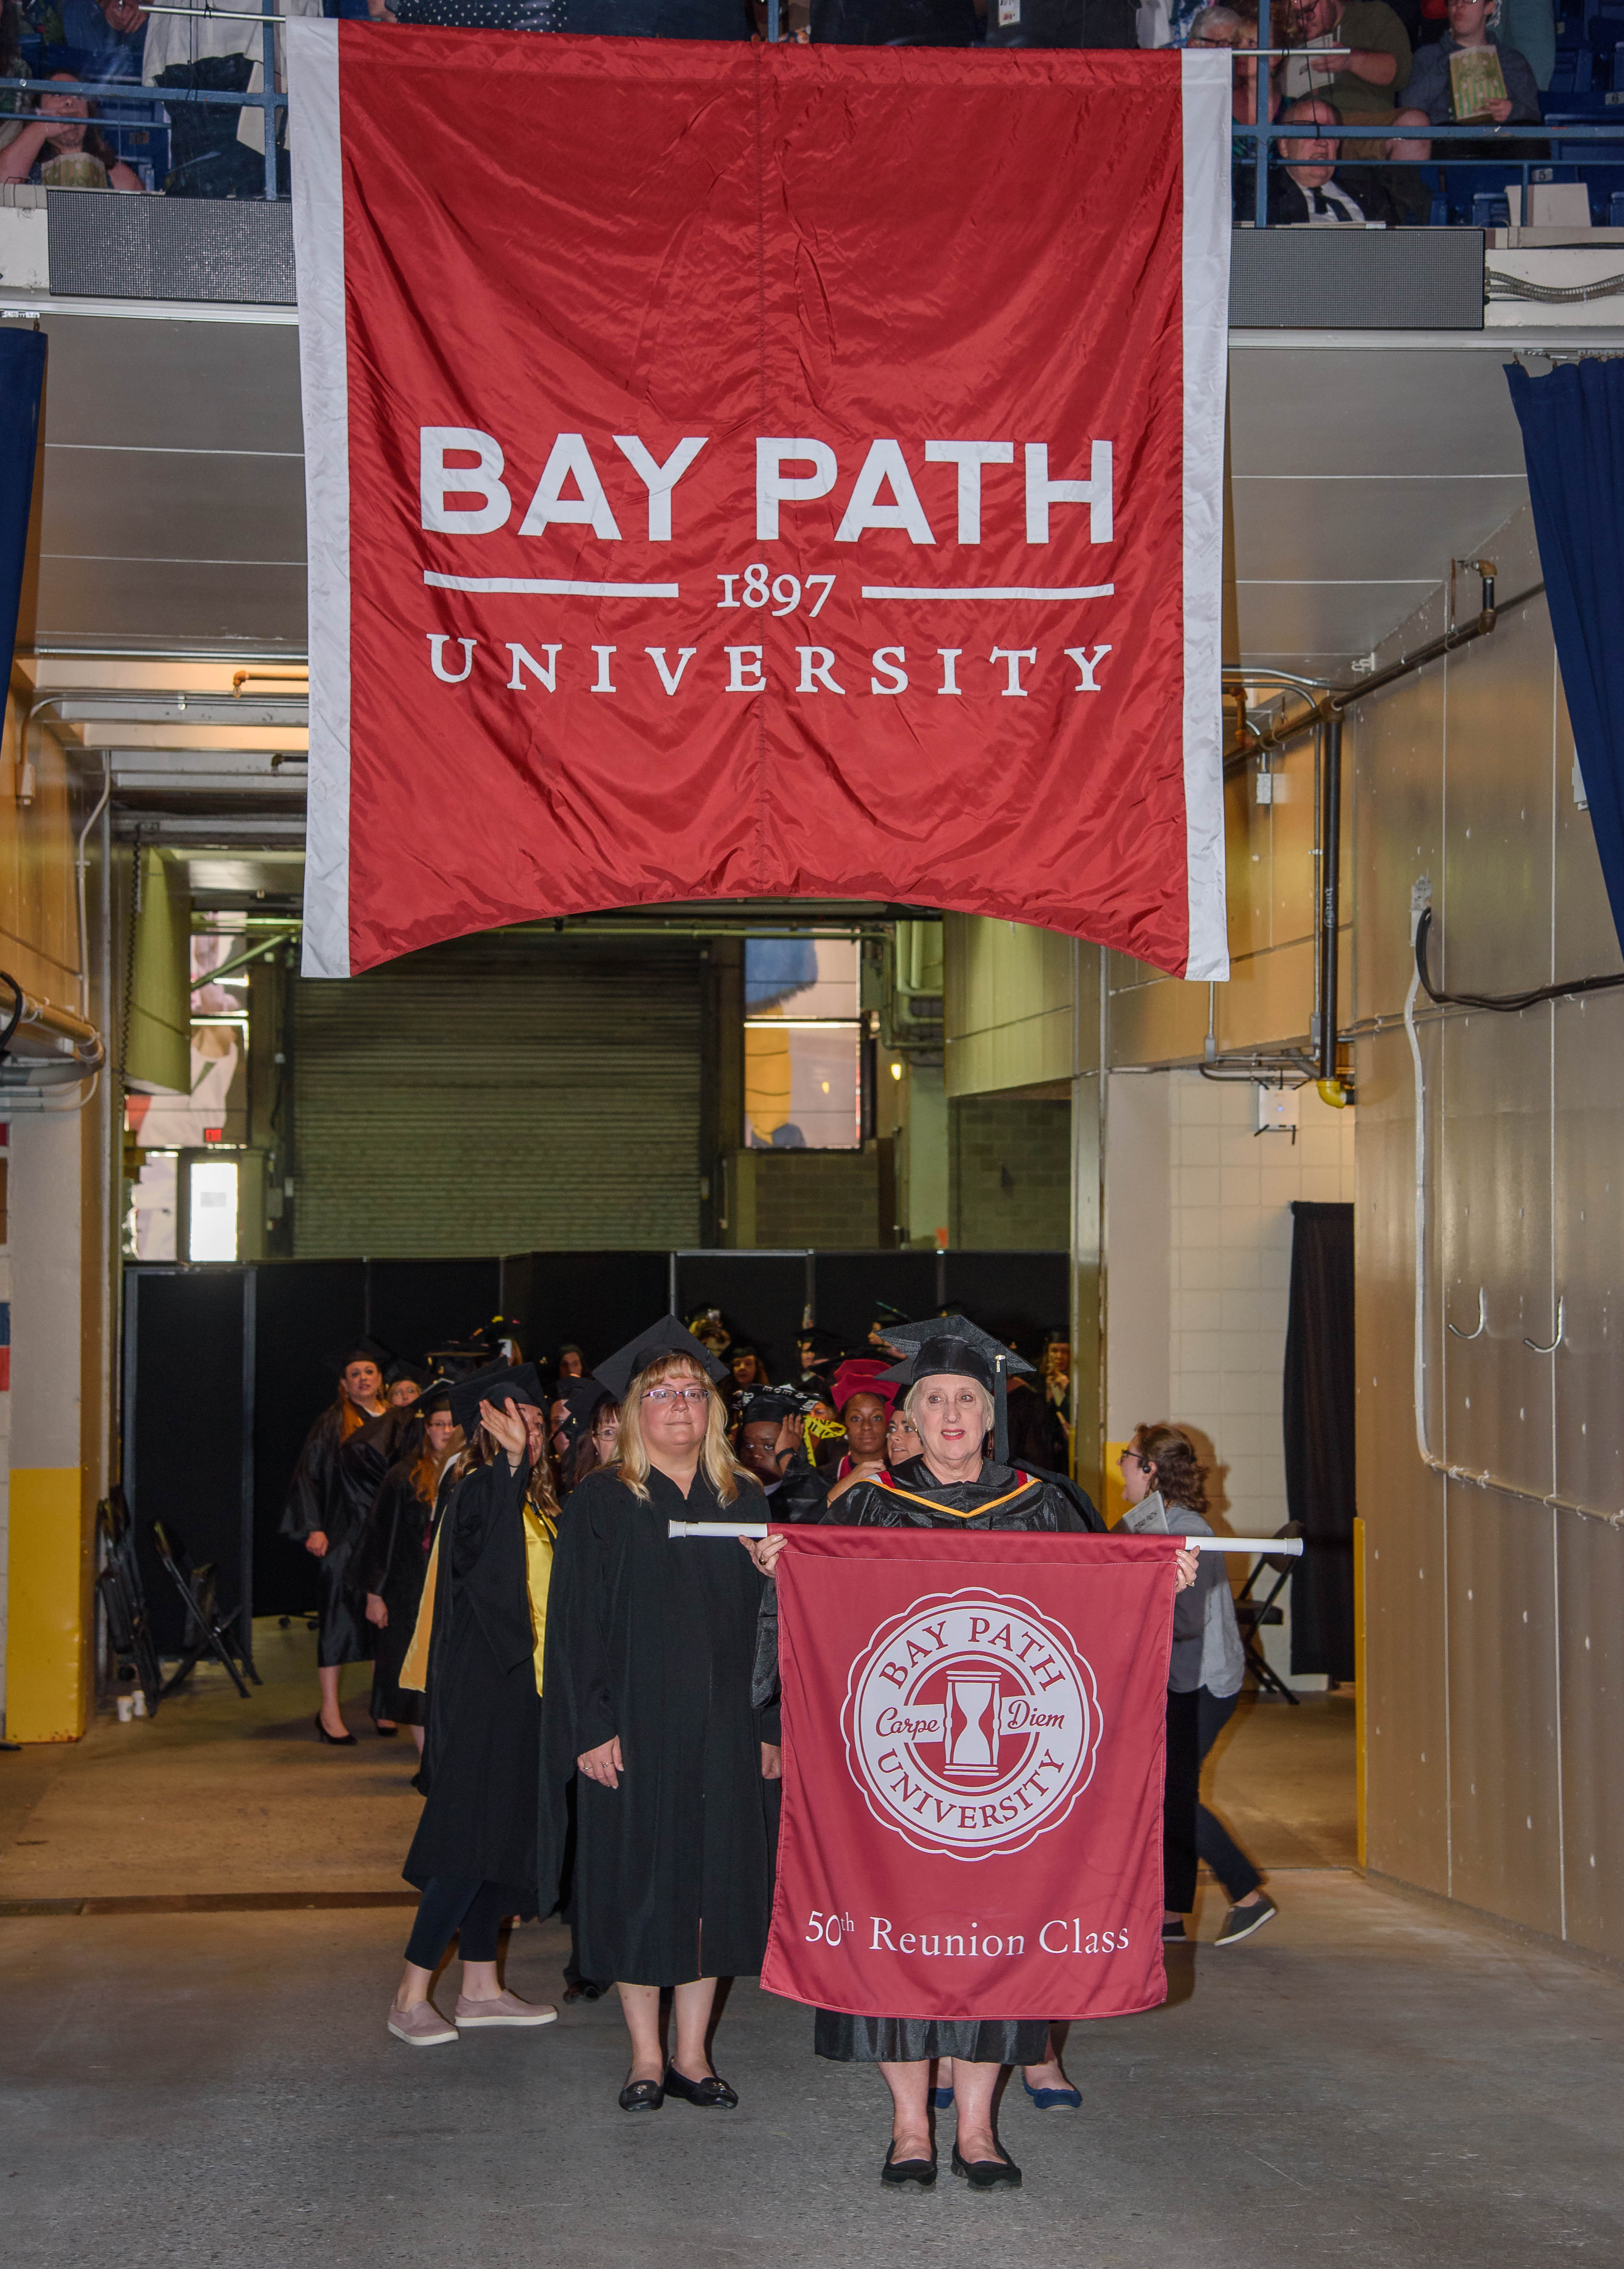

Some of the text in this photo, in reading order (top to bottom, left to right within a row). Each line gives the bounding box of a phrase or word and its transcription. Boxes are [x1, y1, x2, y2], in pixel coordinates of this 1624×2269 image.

[420, 427, 1113, 544] BAY PATH
[717, 564, 836, 617] 1897
[427, 634, 1112, 696] UNIVERSITY
[879, 1617, 1065, 1691] BAY PATH
[876, 1700, 1064, 1740] Carpe Diem
[878, 1748, 1064, 1828] UNIVERSITY
[806, 1911, 1129, 1956] 50th Reunion Class
